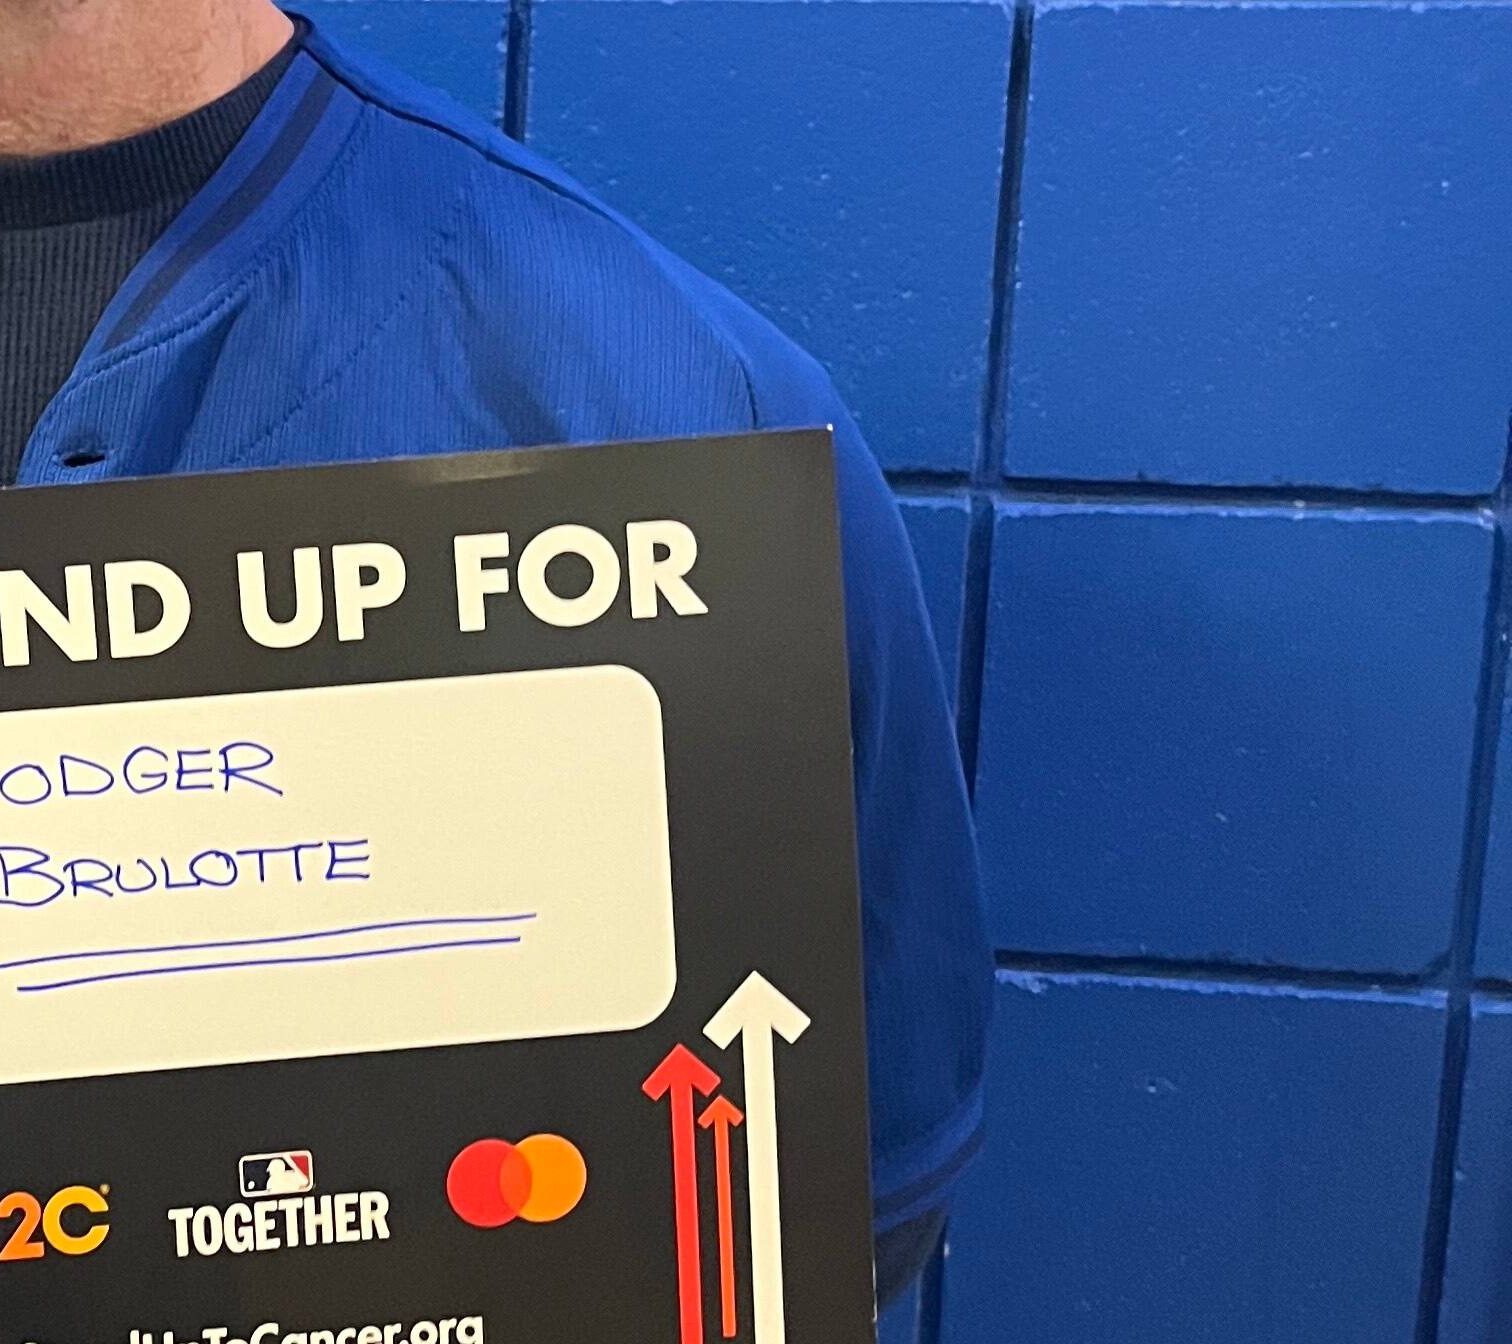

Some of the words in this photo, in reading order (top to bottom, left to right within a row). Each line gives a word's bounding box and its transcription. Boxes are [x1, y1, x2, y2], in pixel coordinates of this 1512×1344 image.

[236, 541, 407, 649] UP
[453, 519, 710, 633] FOR
[167, 1190, 391, 1258] TOGETHER
